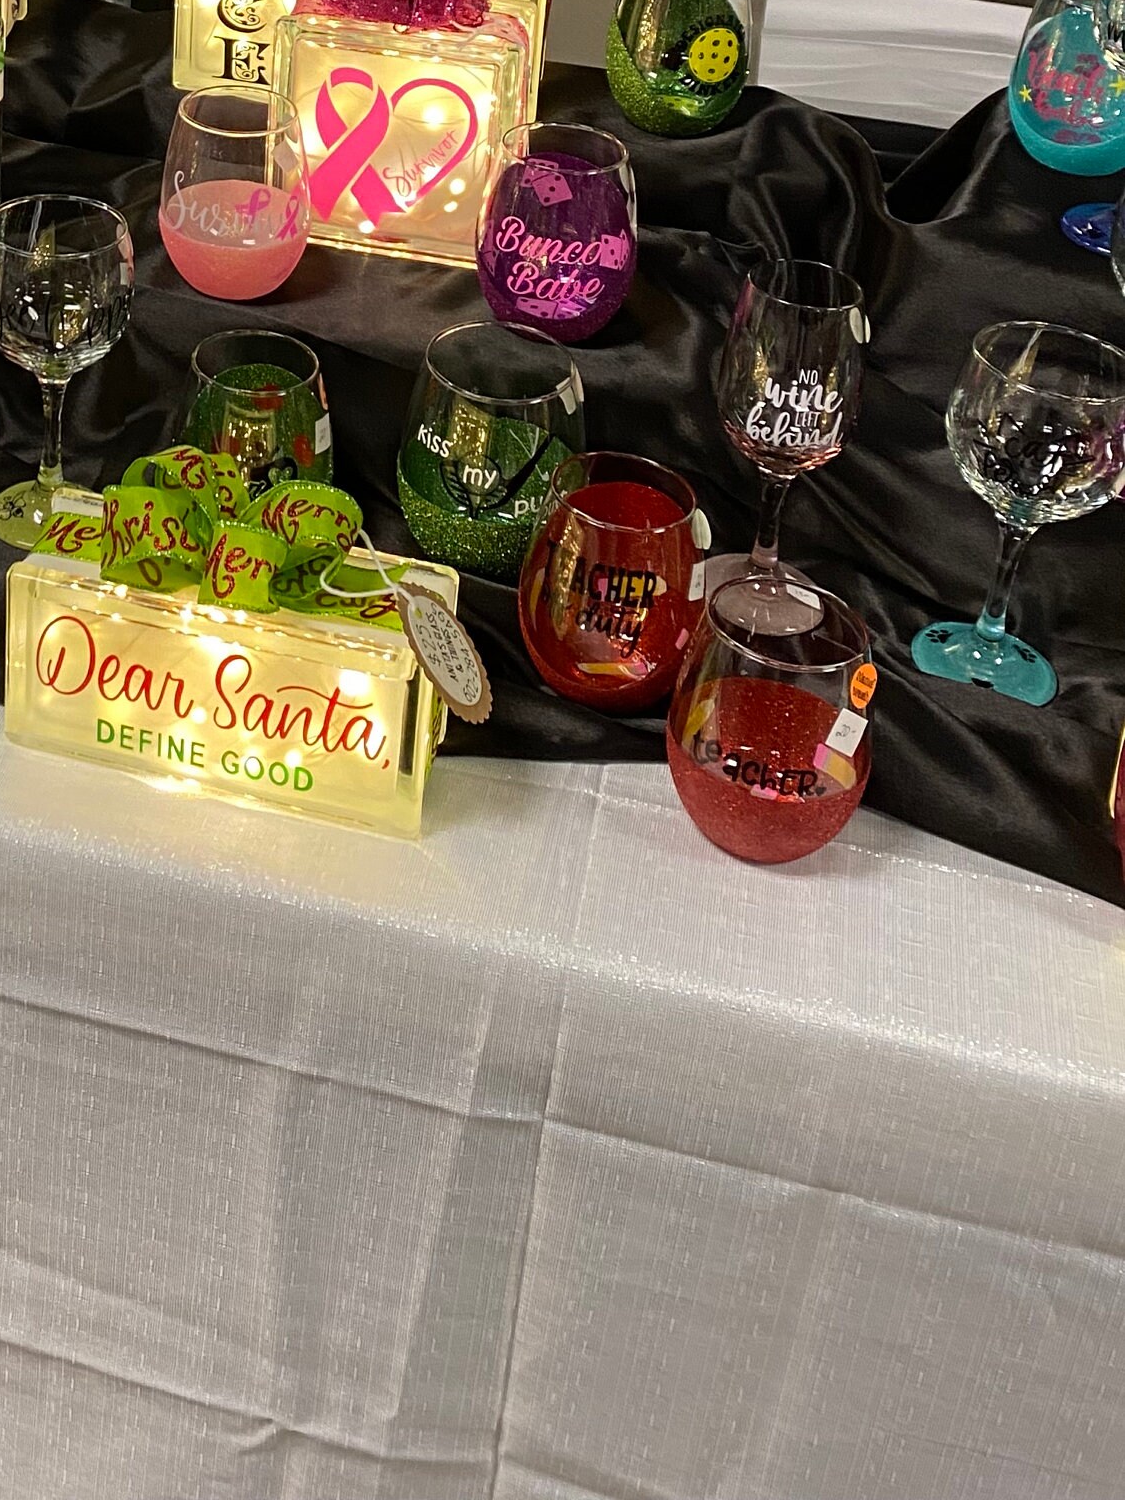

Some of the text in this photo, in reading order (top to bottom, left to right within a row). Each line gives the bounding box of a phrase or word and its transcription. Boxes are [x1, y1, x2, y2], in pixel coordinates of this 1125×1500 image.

[381, 130, 460, 198] Survivor
[495, 215, 605, 266] Bunco
[506, 260, 606, 301] Babe
[764, 377, 844, 414] wine
[798, 368, 819, 386] NO
[417, 423, 454, 459] kiss
[746, 401, 844, 448] behind
[462, 464, 497, 490] my
[415, 624, 442, 668] $25
[576, 602, 642, 659] duty
[35, 615, 391, 771] Dear Santa,
[95, 718, 315, 792] DEFINE GOOD
